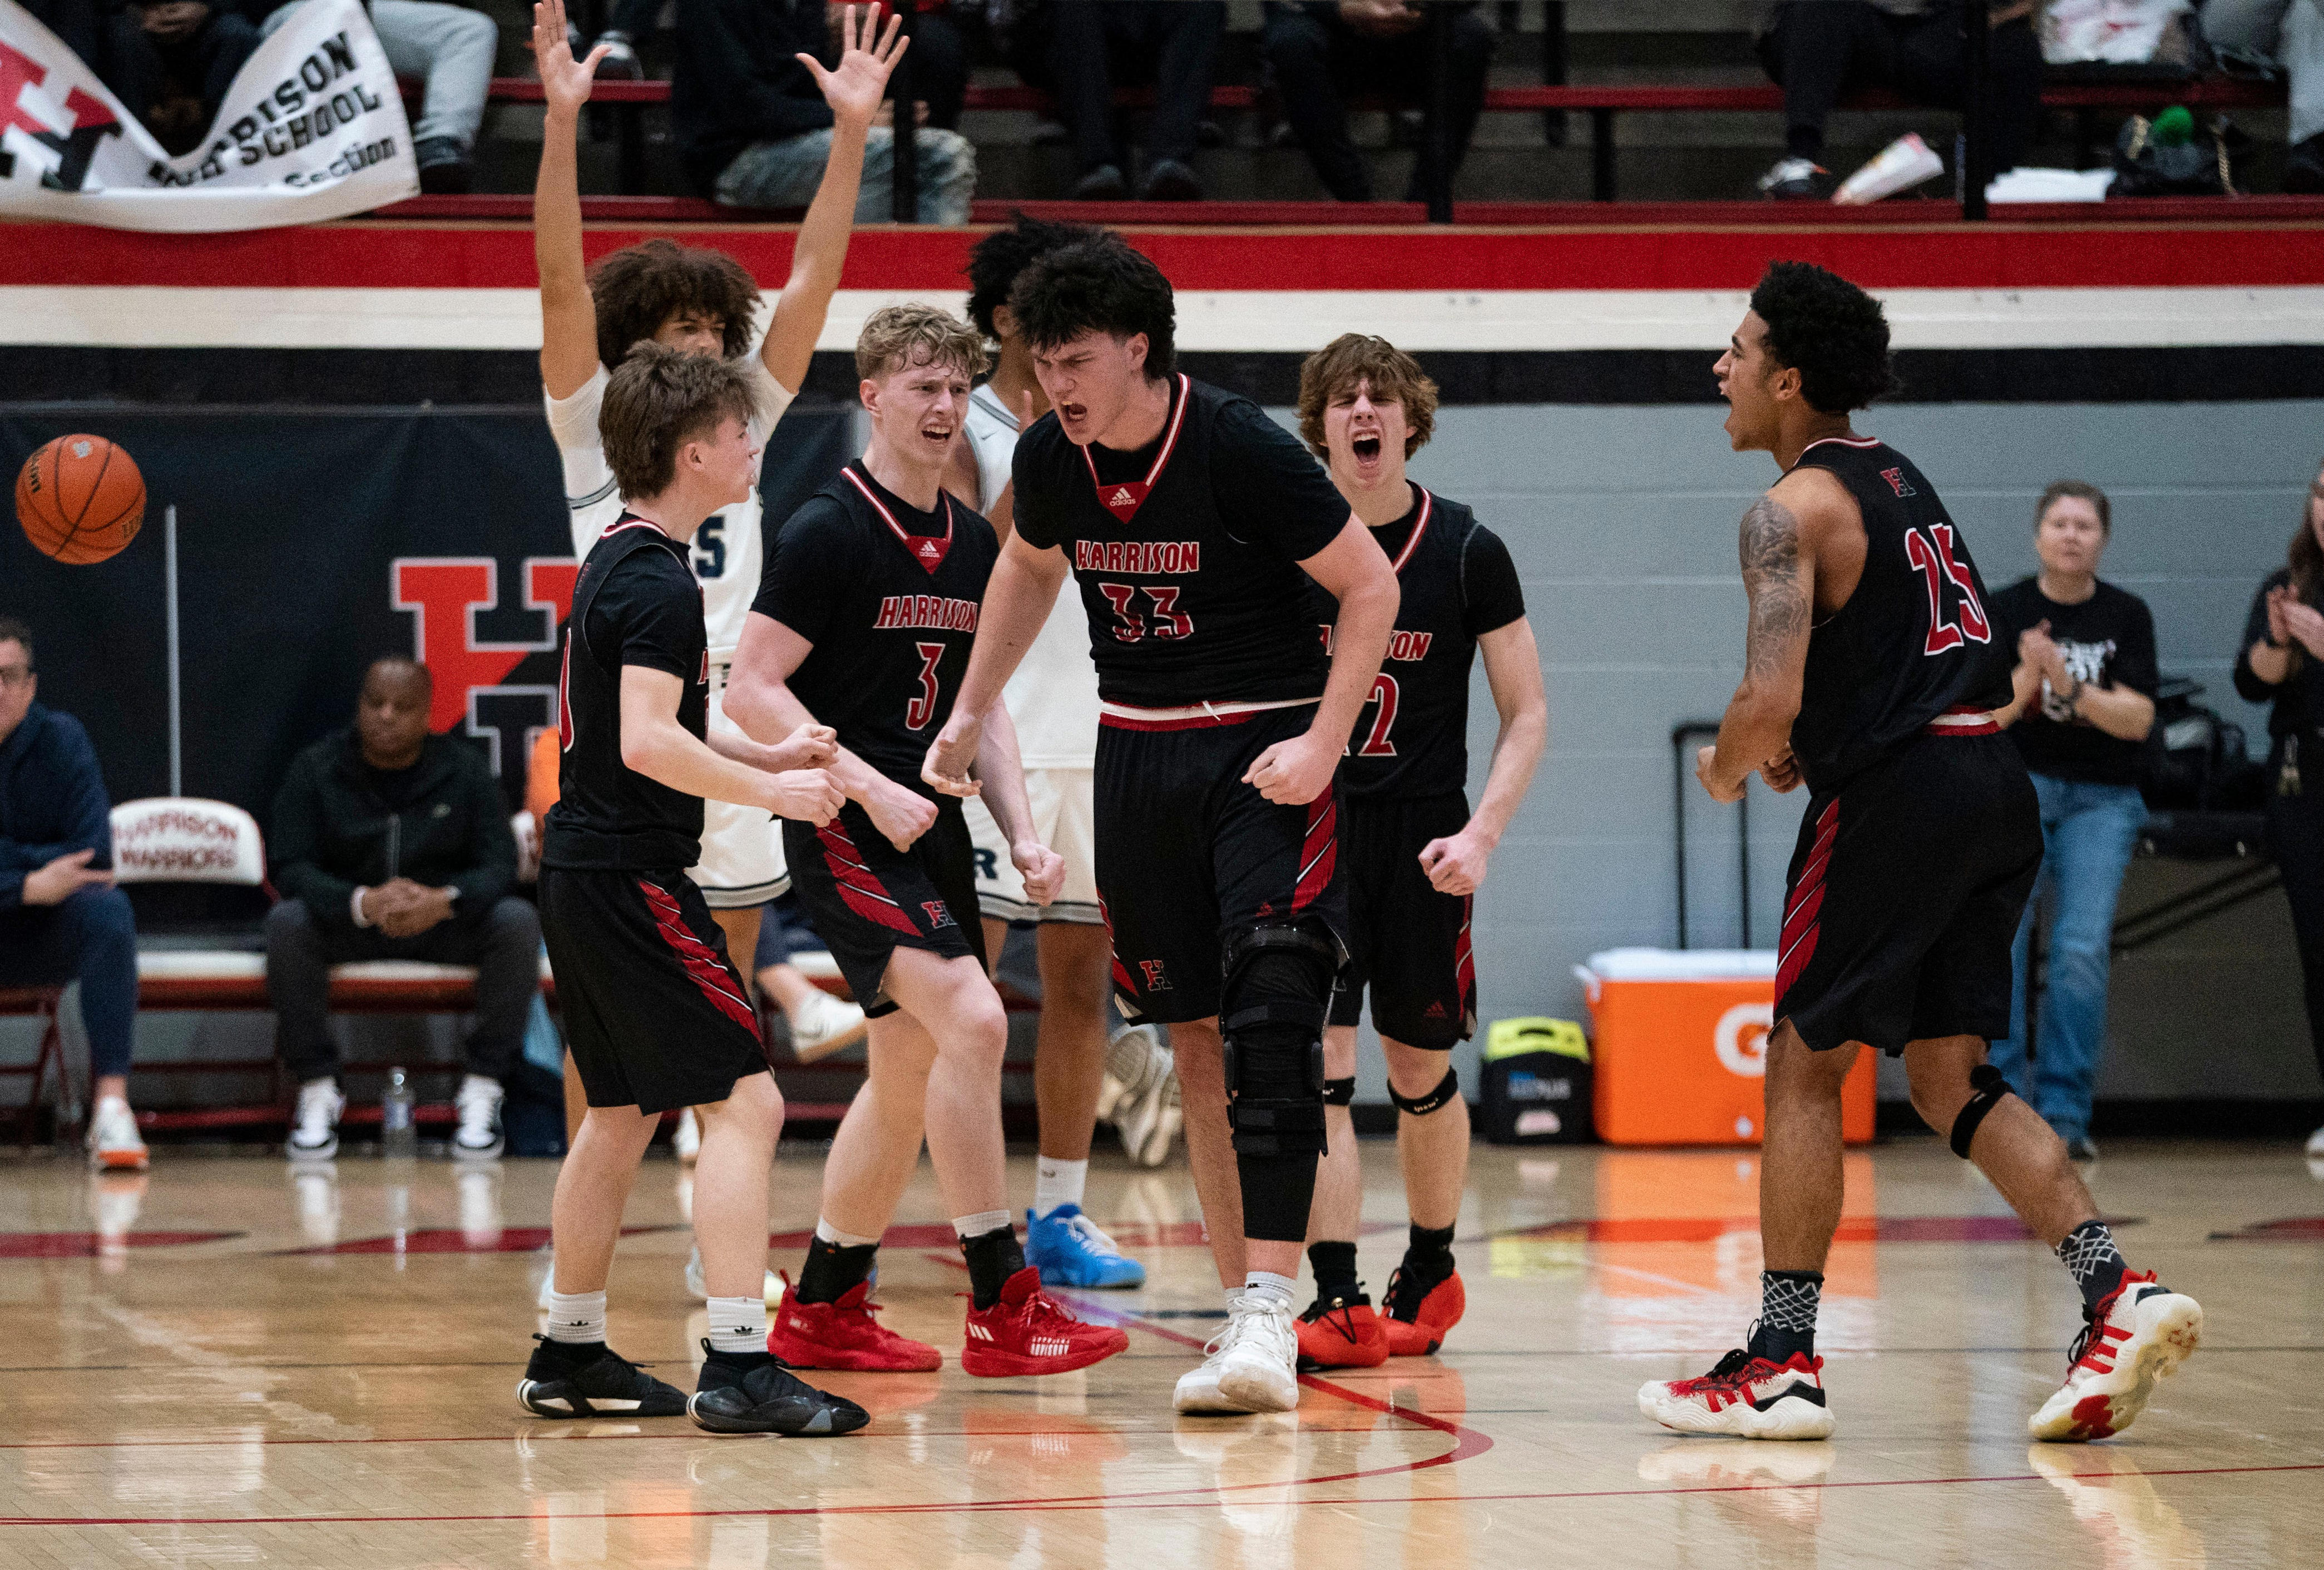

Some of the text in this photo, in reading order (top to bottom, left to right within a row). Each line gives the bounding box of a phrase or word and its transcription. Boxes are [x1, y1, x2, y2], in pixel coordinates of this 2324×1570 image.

[238, 85, 382, 166] SCHOOL
[284, 137, 398, 189] Section
[1110, 498, 1136, 507] adidas
[1076, 539, 1200, 574] HARRISON
[1905, 522, 1991, 656] 25
[872, 595, 979, 633] HARRISON
[1098, 582, 1194, 642] 33
[906, 642, 946, 730] 3
[1342, 672, 1400, 756] 2
[1714, 1003, 1774, 1077] G
